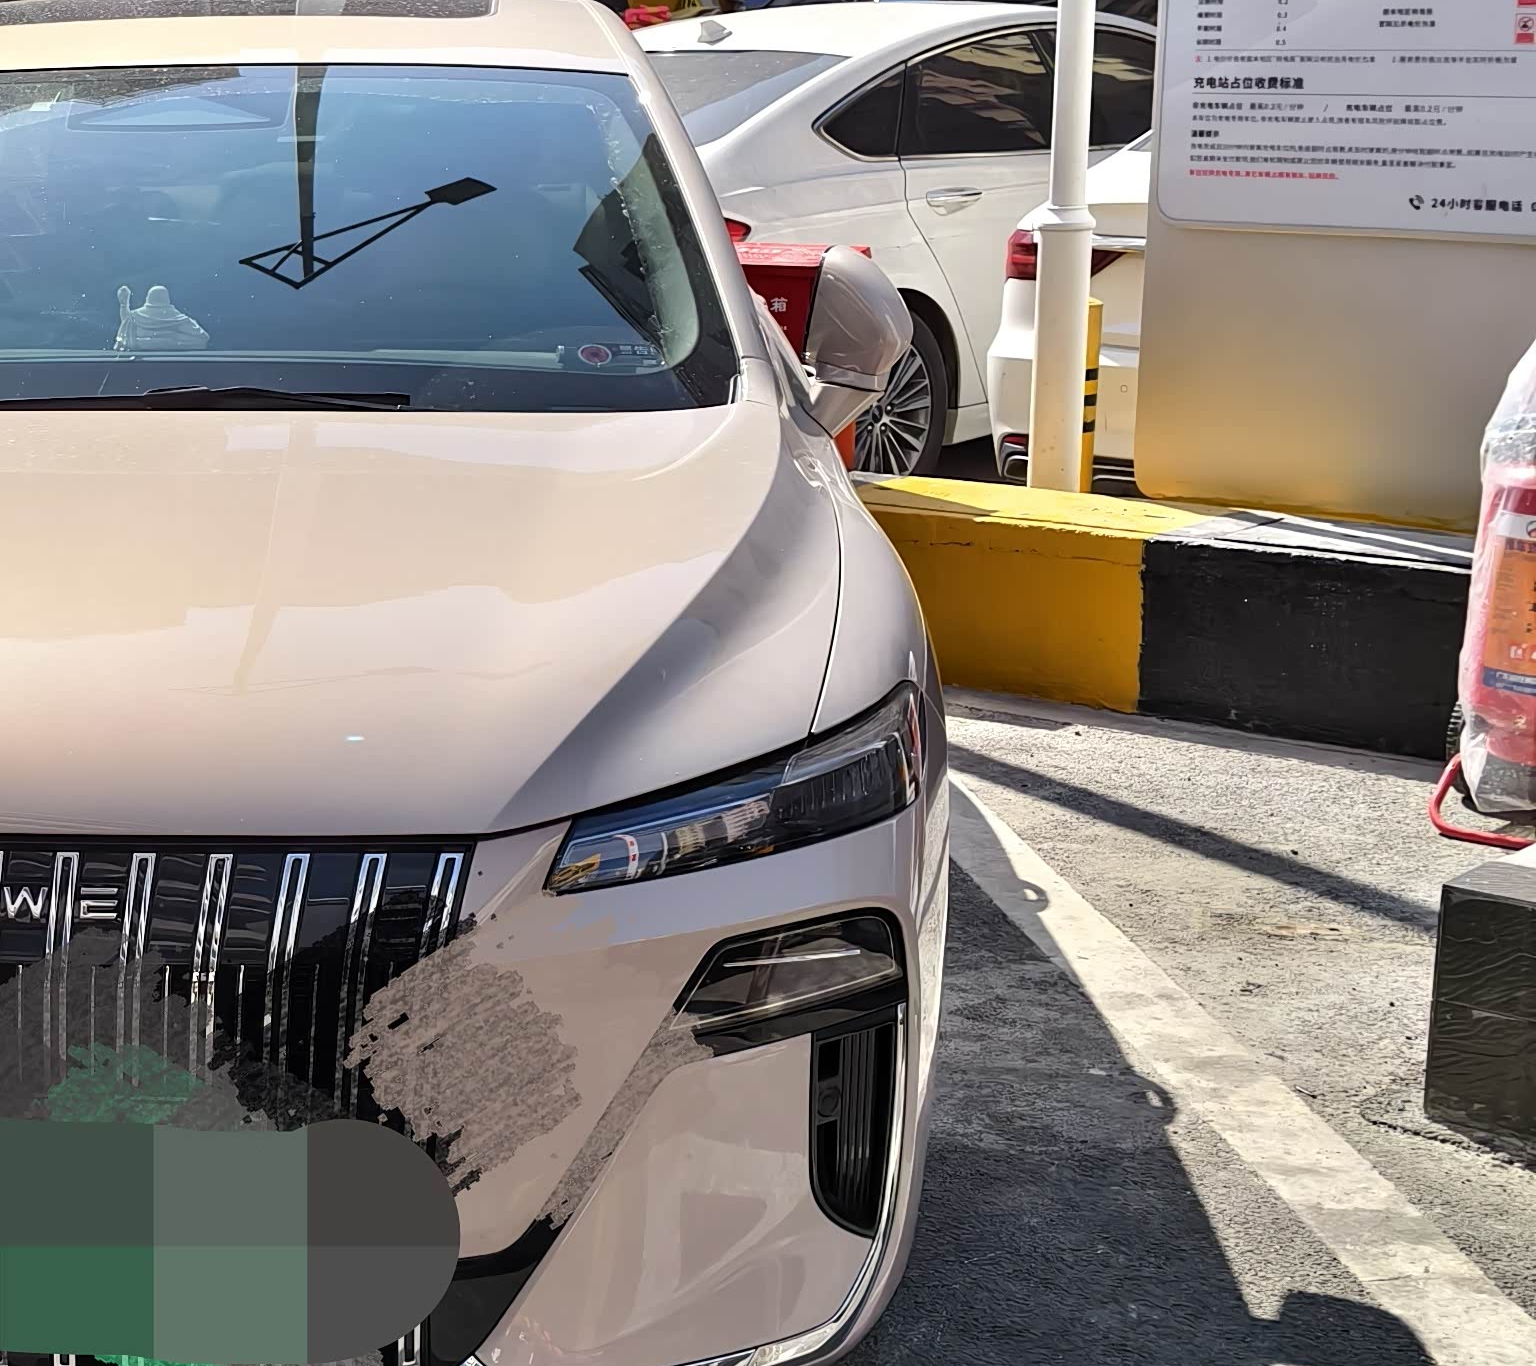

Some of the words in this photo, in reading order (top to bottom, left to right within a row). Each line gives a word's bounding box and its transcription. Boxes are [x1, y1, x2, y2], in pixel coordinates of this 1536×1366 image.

[1193, 76, 1304, 90] 充电站占位收费标准
